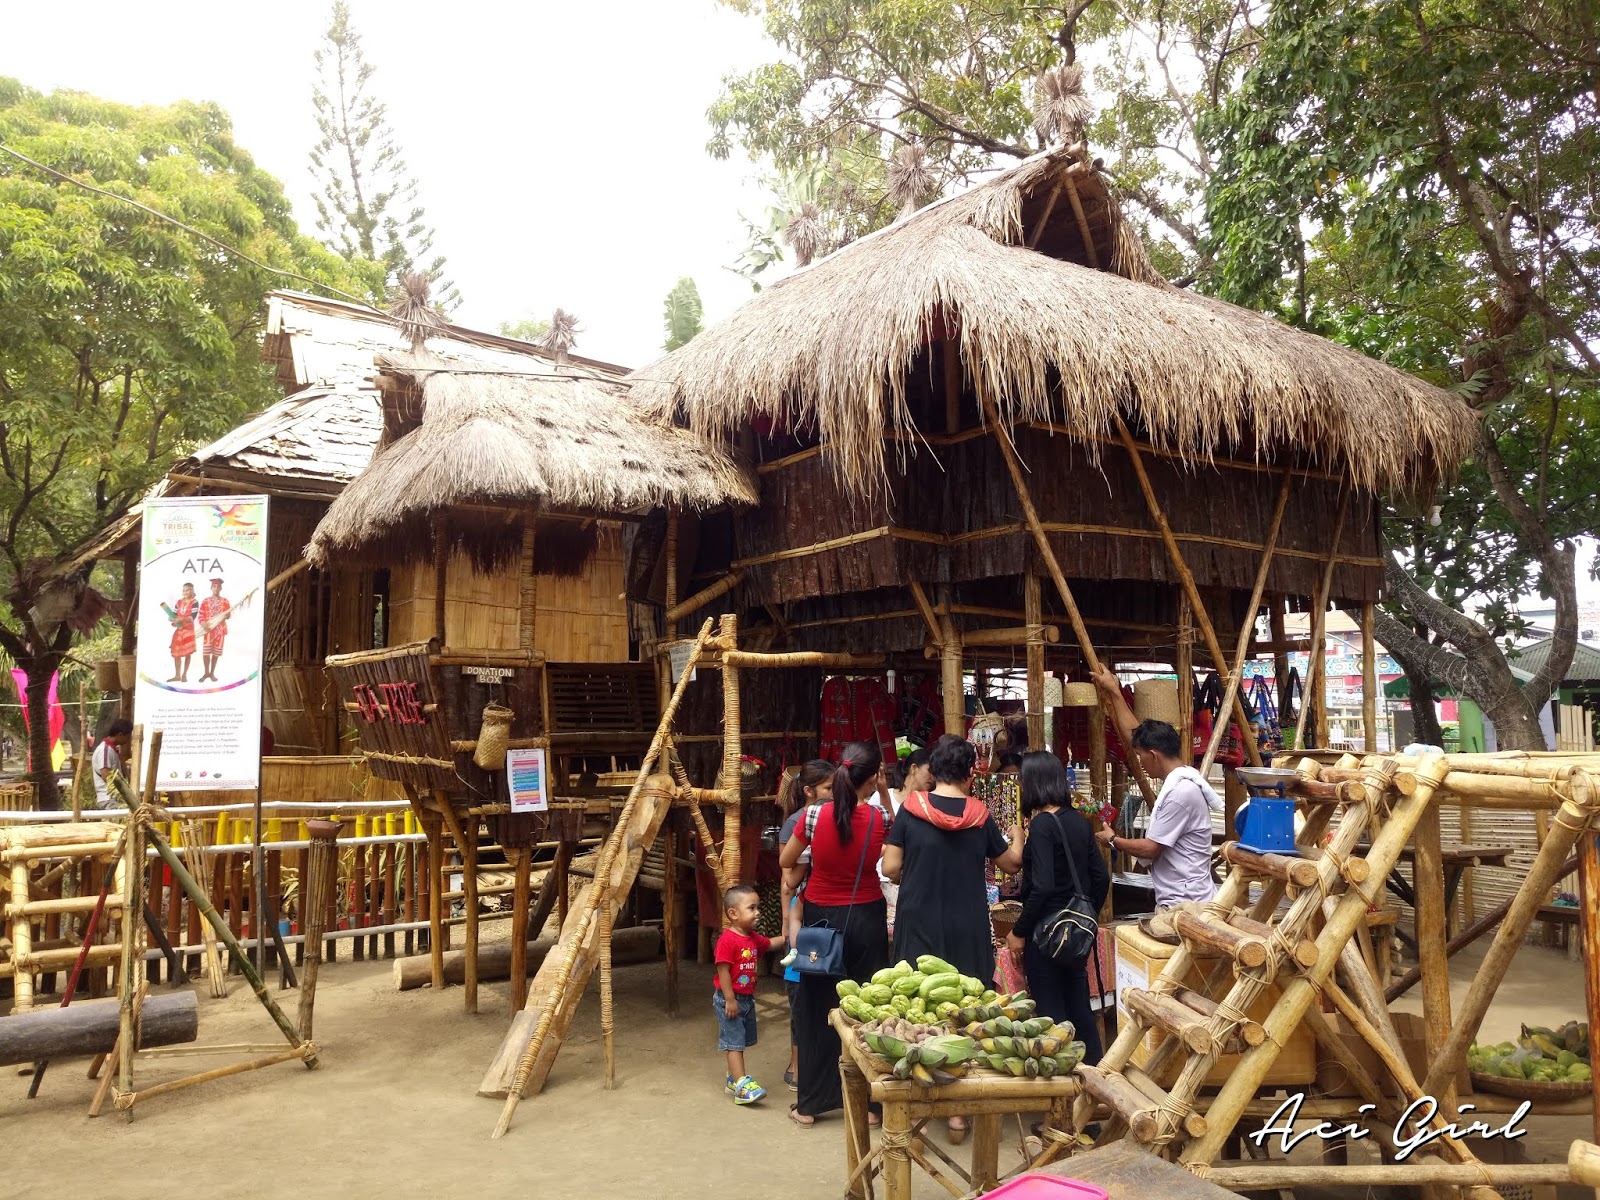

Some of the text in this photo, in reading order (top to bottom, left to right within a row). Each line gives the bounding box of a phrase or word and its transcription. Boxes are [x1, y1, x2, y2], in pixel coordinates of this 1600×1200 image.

[182, 558, 224, 574] ATA
[480, 675, 501, 684] BOX
[378, 681, 427, 725] TRIBE
